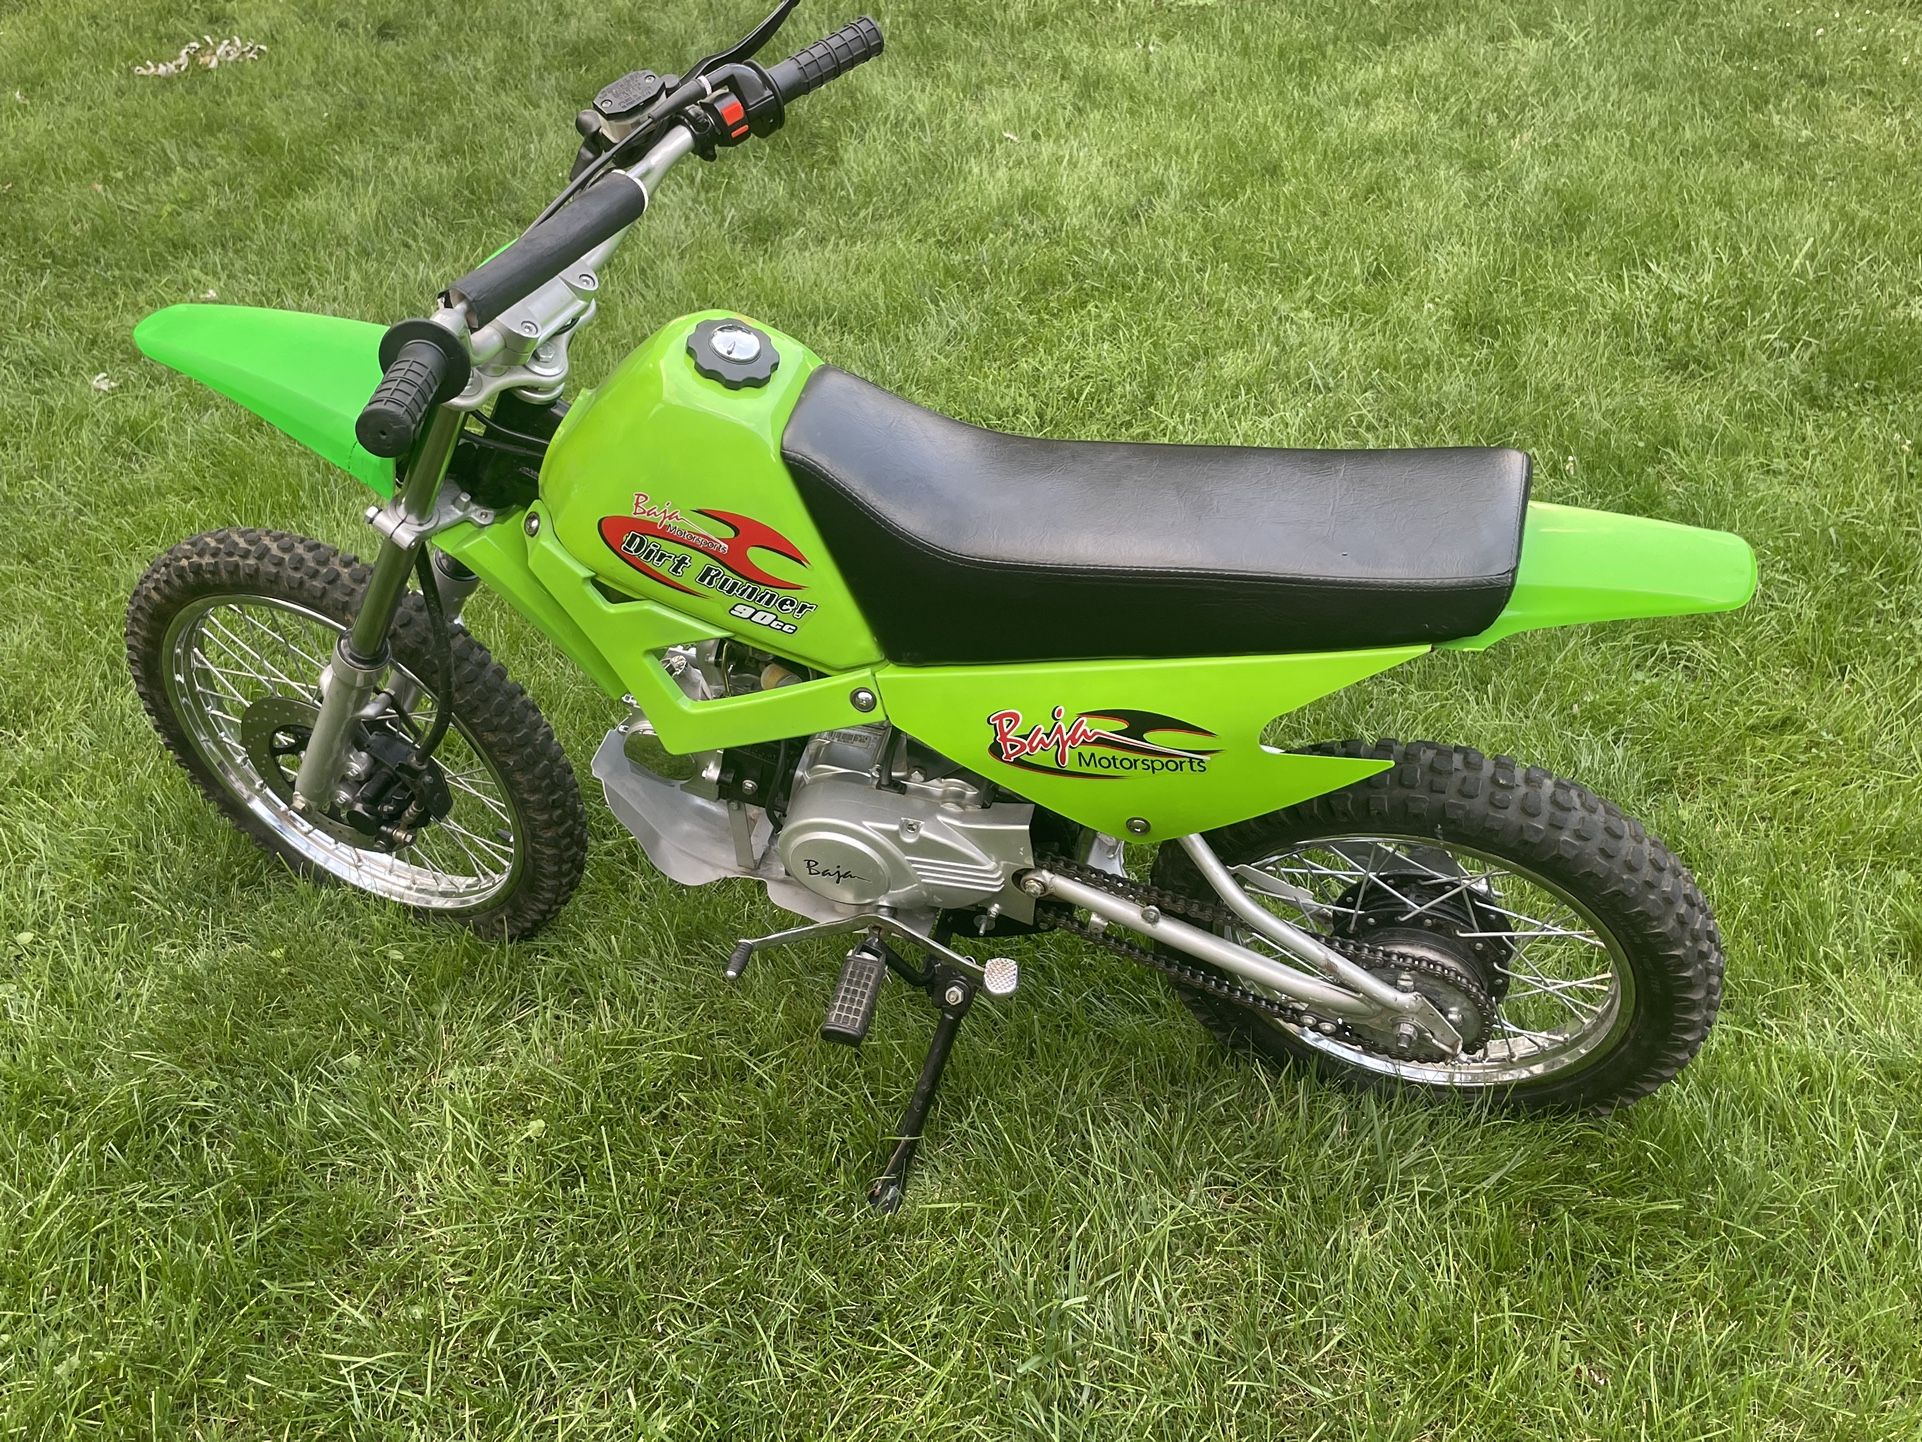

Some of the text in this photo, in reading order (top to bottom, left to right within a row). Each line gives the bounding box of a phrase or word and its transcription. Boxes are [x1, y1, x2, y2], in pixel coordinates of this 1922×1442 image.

[632, 492, 689, 529] Baja
[666, 523, 728, 554] Motorsports
[621, 531, 817, 619] Dirt Runner
[729, 603, 798, 634] 90cc
[987, 706, 1112, 767] Baja
[1077, 752, 1207, 774] Motorsports
[803, 859, 871, 884] Baja
